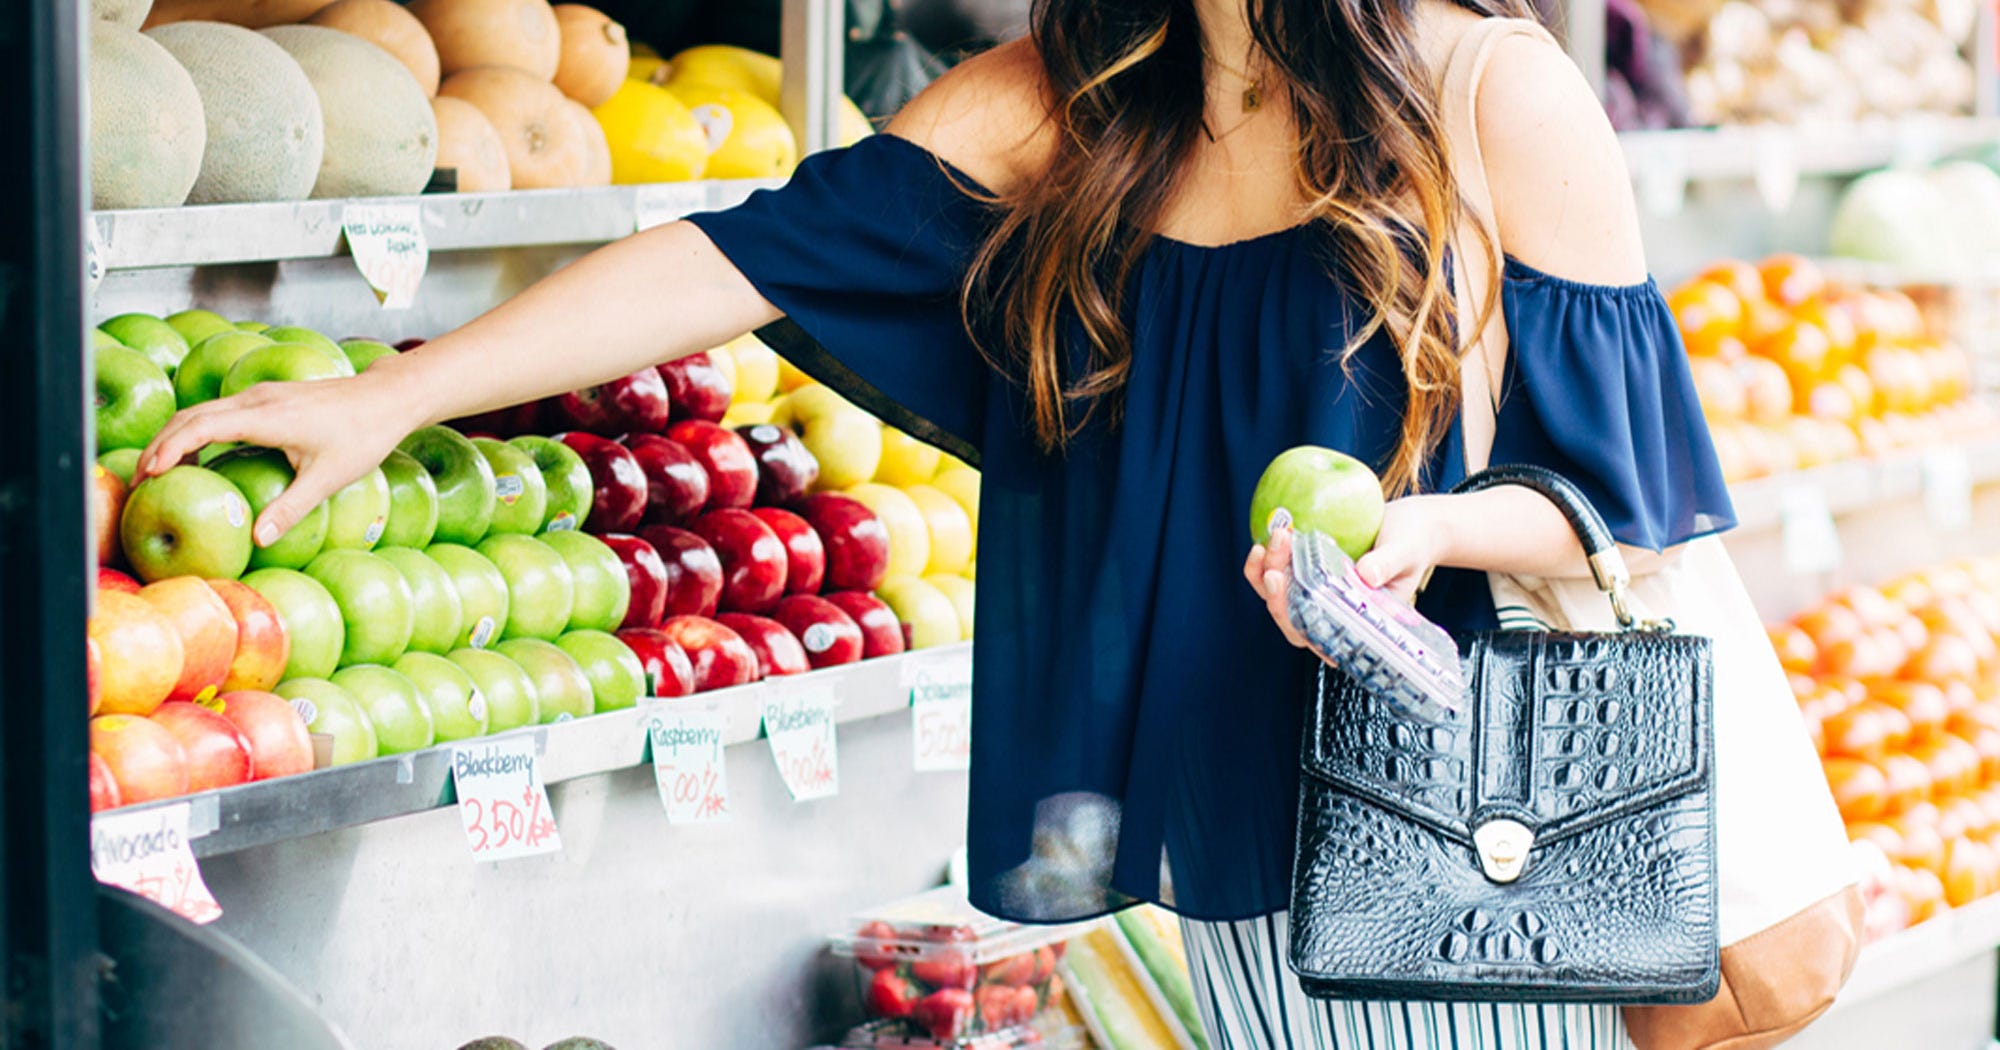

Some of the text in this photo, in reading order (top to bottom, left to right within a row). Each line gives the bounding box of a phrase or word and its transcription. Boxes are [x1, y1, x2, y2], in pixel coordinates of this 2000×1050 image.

[651, 717, 721, 762] Raspberry
[456, 746, 534, 787] Blackberry
[92, 815, 179, 871] Avocado
